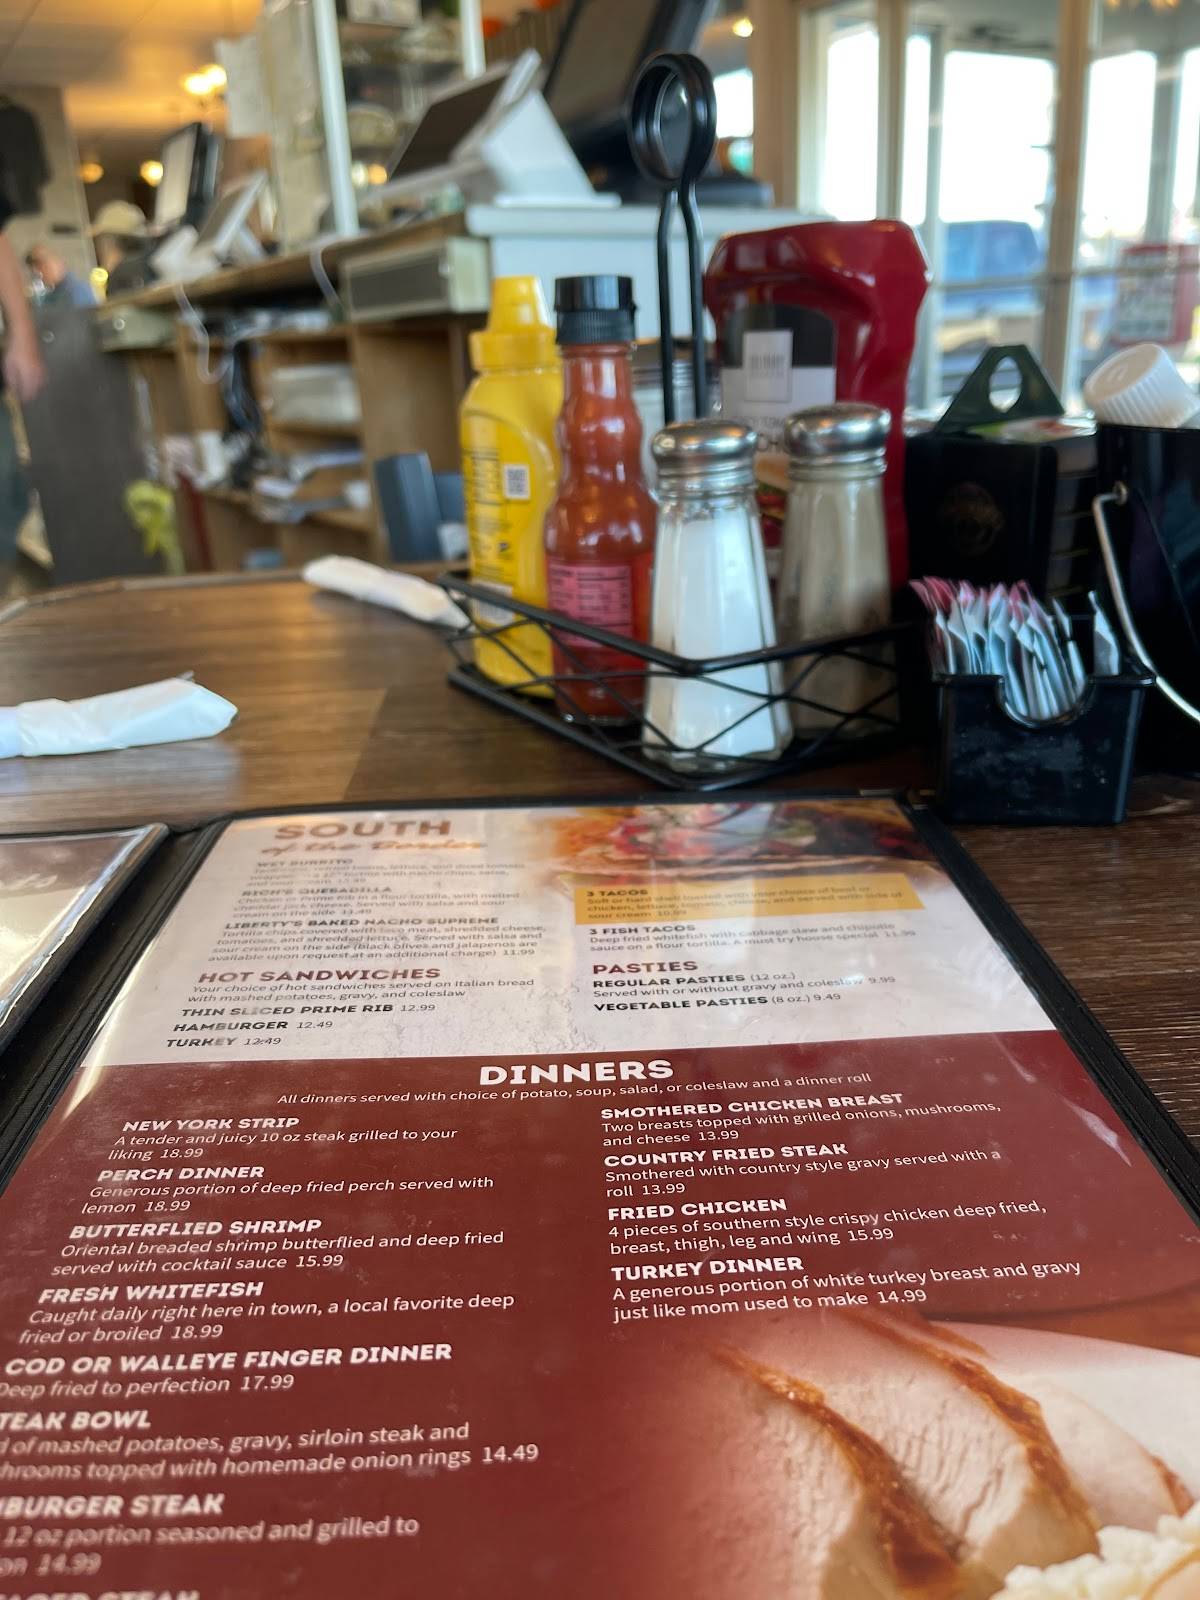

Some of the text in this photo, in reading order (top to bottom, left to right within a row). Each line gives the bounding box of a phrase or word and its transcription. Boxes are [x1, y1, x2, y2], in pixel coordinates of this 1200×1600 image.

[273, 820, 452, 840] SOUTH
[600, 889, 647, 897] TACOS
[224, 916, 499, 930] LIBERTY'S BAKED NACHO SUPREME
[603, 926, 637, 935] FISH
[644, 925, 694, 933] TACOS
[197, 968, 442, 983] HOT SANDWICHES
[593, 961, 696, 974] PASTIES
[309, 982, 387, 990] sandwiches
[388, 981, 432, 989] served
[593, 973, 794, 988] REGULAR PASTIES (12 oz.)
[593, 987, 636, 997] Served
[640, 986, 670, 995] with
[687, 982, 740, 993] without
[740, 982, 775, 992] gravy
[780, 979, 803, 988] and
[274, 993, 337, 1003] potatoes,
[339, 993, 378, 1001] gravy,
[408, 990, 465, 998] coleslaw
[594, 993, 839, 1012] VEGETABLE PASTIES (8 oz.) 9.49
[179, 1004, 436, 1017] THIN SLICED PRIME RIB 12.99
[172, 1020, 333, 1032] HAMBURGER 12.49
[164, 1037, 282, 1048] TURKEY 12.49
[479, 1058, 673, 1086] DINNERS
[276, 1094, 297, 1104] All
[299, 1091, 357, 1103] dinners
[359, 1089, 410, 1101] served
[413, 1088, 447, 1099] with
[449, 1086, 499, 1098] choice
[501, 1086, 517, 1096] of
[520, 1084, 574, 1097] potato,
[576, 1086, 616, 1096] soup,
[620, 1084, 663, 1094] salad,
[686, 1080, 748, 1090] coleslaw
[752, 1076, 781, 1087] and
[783, 1078, 793, 1086] a
[795, 1074, 842, 1086] dinner
[846, 1073, 872, 1084] roll
[601, 1093, 902, 1119] SMOTHERED CHICKEN BREAST
[121, 1116, 300, 1132] NEW YORK STRIP
[601, 1102, 1000, 1132] Two breasts topped with grilled onions, mushrooms,
[113, 1129, 457, 1147] A tender and juicy 10 oz steak grilled to your
[602, 1130, 739, 1146] and cheese 13.99
[107, 1146, 205, 1163] liking 18.99
[604, 1143, 848, 1167] COUNTRY FRIED STEAK
[96, 1166, 266, 1182] PERCH DINNER
[88, 1175, 496, 1199] Generous portion of deep fried perch served with
[80, 1200, 191, 1214] lemon 18.99
[607, 1198, 786, 1221] FRIED CHICKEN
[68, 1219, 323, 1240] BUTTERFLIED SHRIMP
[608, 1201, 1046, 1240] 4 pieces of southern style crispy chicken deep fried,
[59, 1230, 507, 1258] Oriental breaded shrimp butterflied and deep fried
[610, 1257, 804, 1282] TURKEY DINNER
[37, 1282, 265, 1303] FRESH WHITEFISH
[2, 1344, 455, 1376] COD OR WALLEYE FINGER DINNER
[0, 1374, 296, 1402] Deep fried to perfection 17.99
[0, 1411, 154, 1432] TEAK BOWL
[129, 1494, 224, 1516] STEAK
